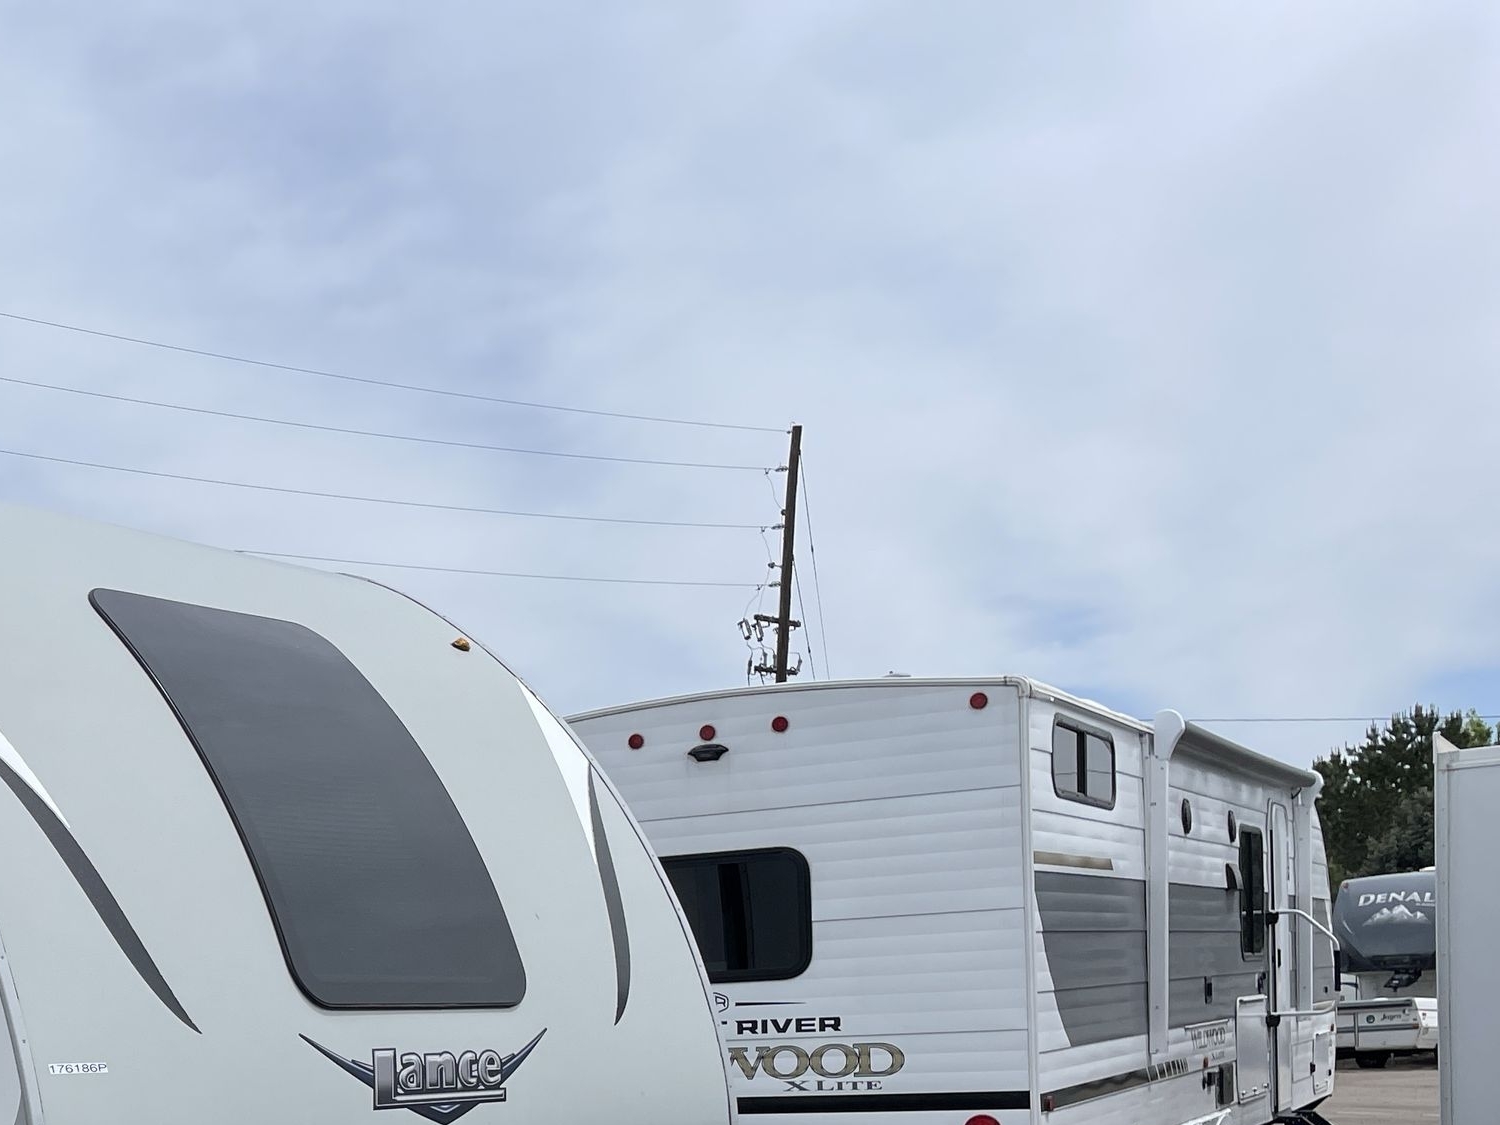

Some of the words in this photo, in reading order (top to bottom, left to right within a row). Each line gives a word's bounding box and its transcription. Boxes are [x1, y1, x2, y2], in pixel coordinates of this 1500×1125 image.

[735, 1016, 842, 1035] RIVER
[49, 1063, 108, 1074] 176186P
[372, 1048, 507, 1110] Lance
[783, 1080, 810, 1092] X
[816, 1080, 883, 1091] LITE
